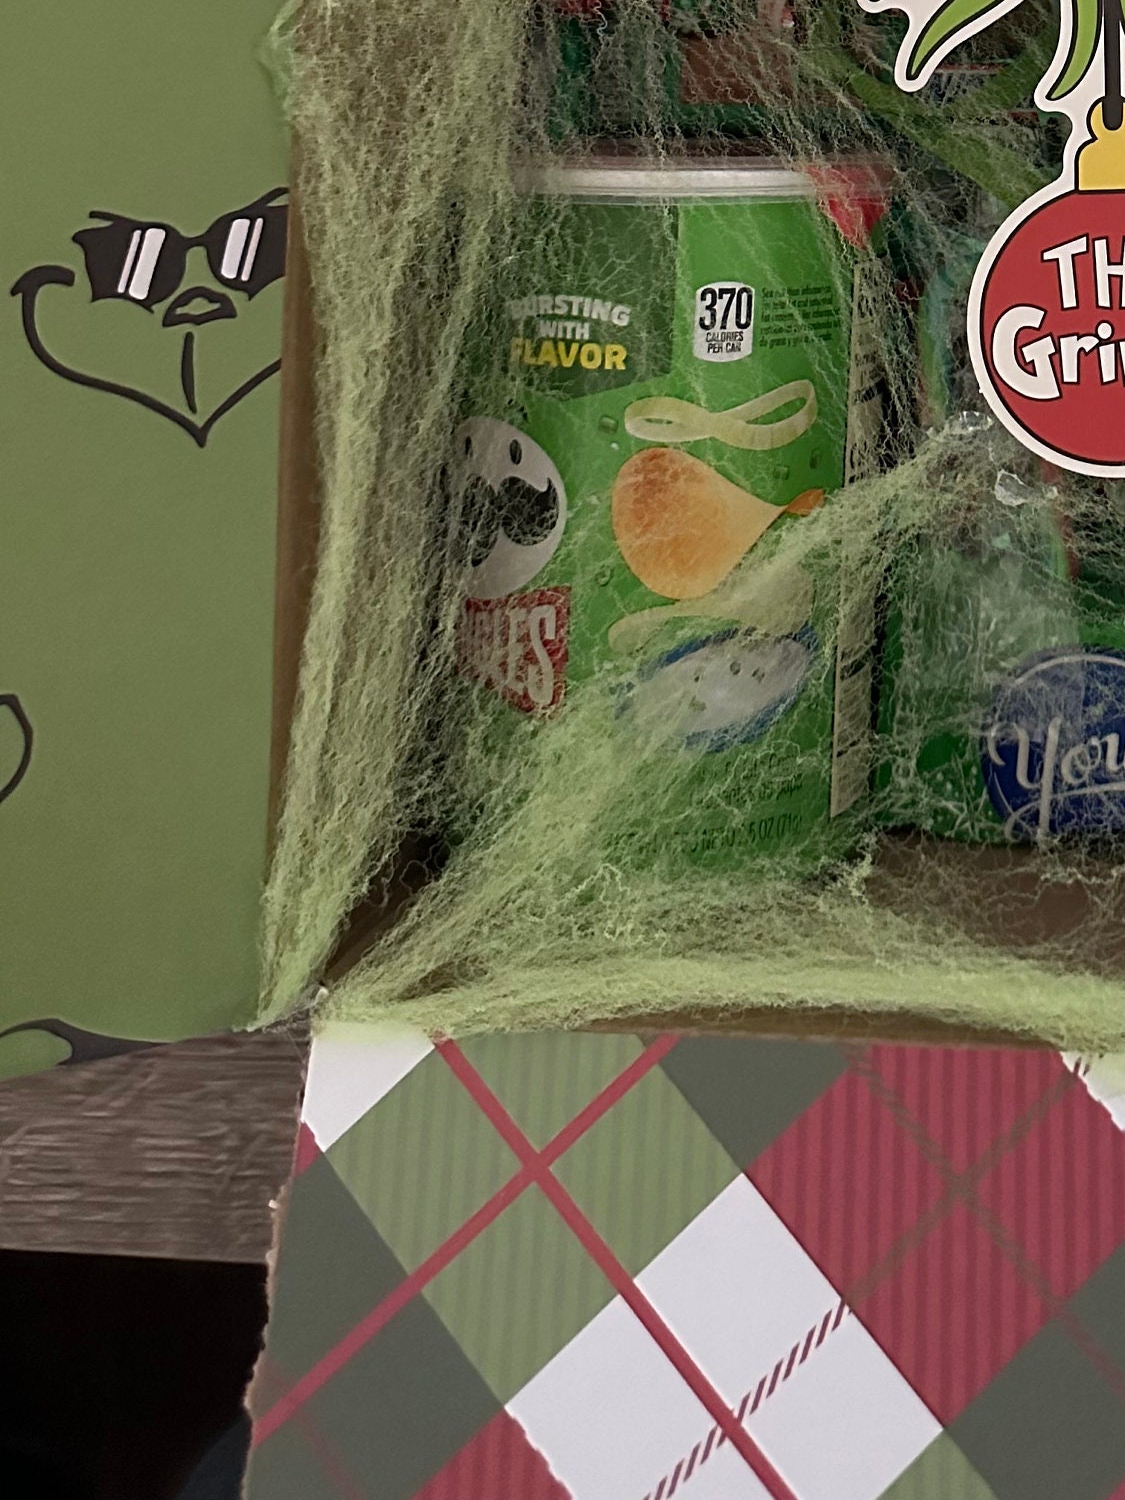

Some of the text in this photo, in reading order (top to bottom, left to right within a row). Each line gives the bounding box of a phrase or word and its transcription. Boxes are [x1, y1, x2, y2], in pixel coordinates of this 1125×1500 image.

[698, 287, 753, 331] 370
[539, 320, 590, 341] WITH
[705, 331, 744, 343] CALORIES
[510, 337, 627, 371] FLAVOR
[707, 342, 742, 354] PER CAN
